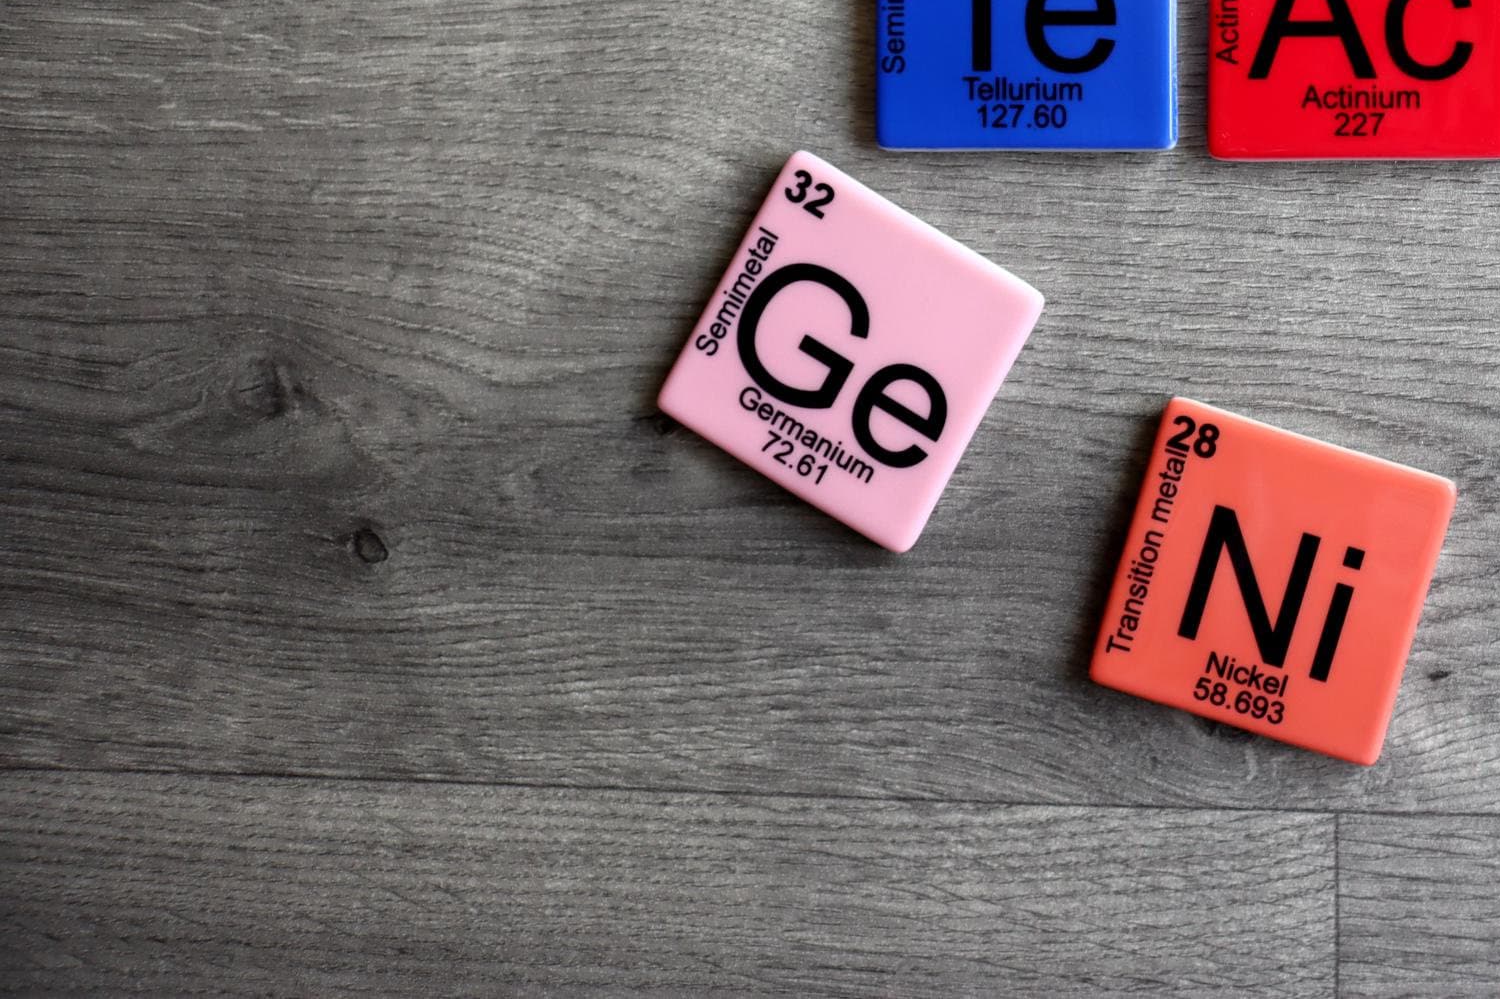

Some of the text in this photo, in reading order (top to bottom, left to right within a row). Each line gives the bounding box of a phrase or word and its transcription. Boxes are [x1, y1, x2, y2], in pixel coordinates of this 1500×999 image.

[962, 75, 1083, 102] Tellurium
[1301, 84, 1421, 110] Actinium
[977, 103, 1067, 129] 127.60
[1334, 111, 1385, 137] 227
[784, 169, 836, 220] 32
[696, 226, 779, 357] Semimetal
[735, 262, 948, 469] Ge
[738, 386, 875, 484] Germanium
[761, 429, 829, 485] 72.61
[1173, 415, 1220, 459] 28
[1105, 447, 1188, 654] Transition metal
[1177, 504, 1366, 683] Ni
[1205, 651, 1289, 698] Nickel
[1193, 676, 1285, 725] 58.693
